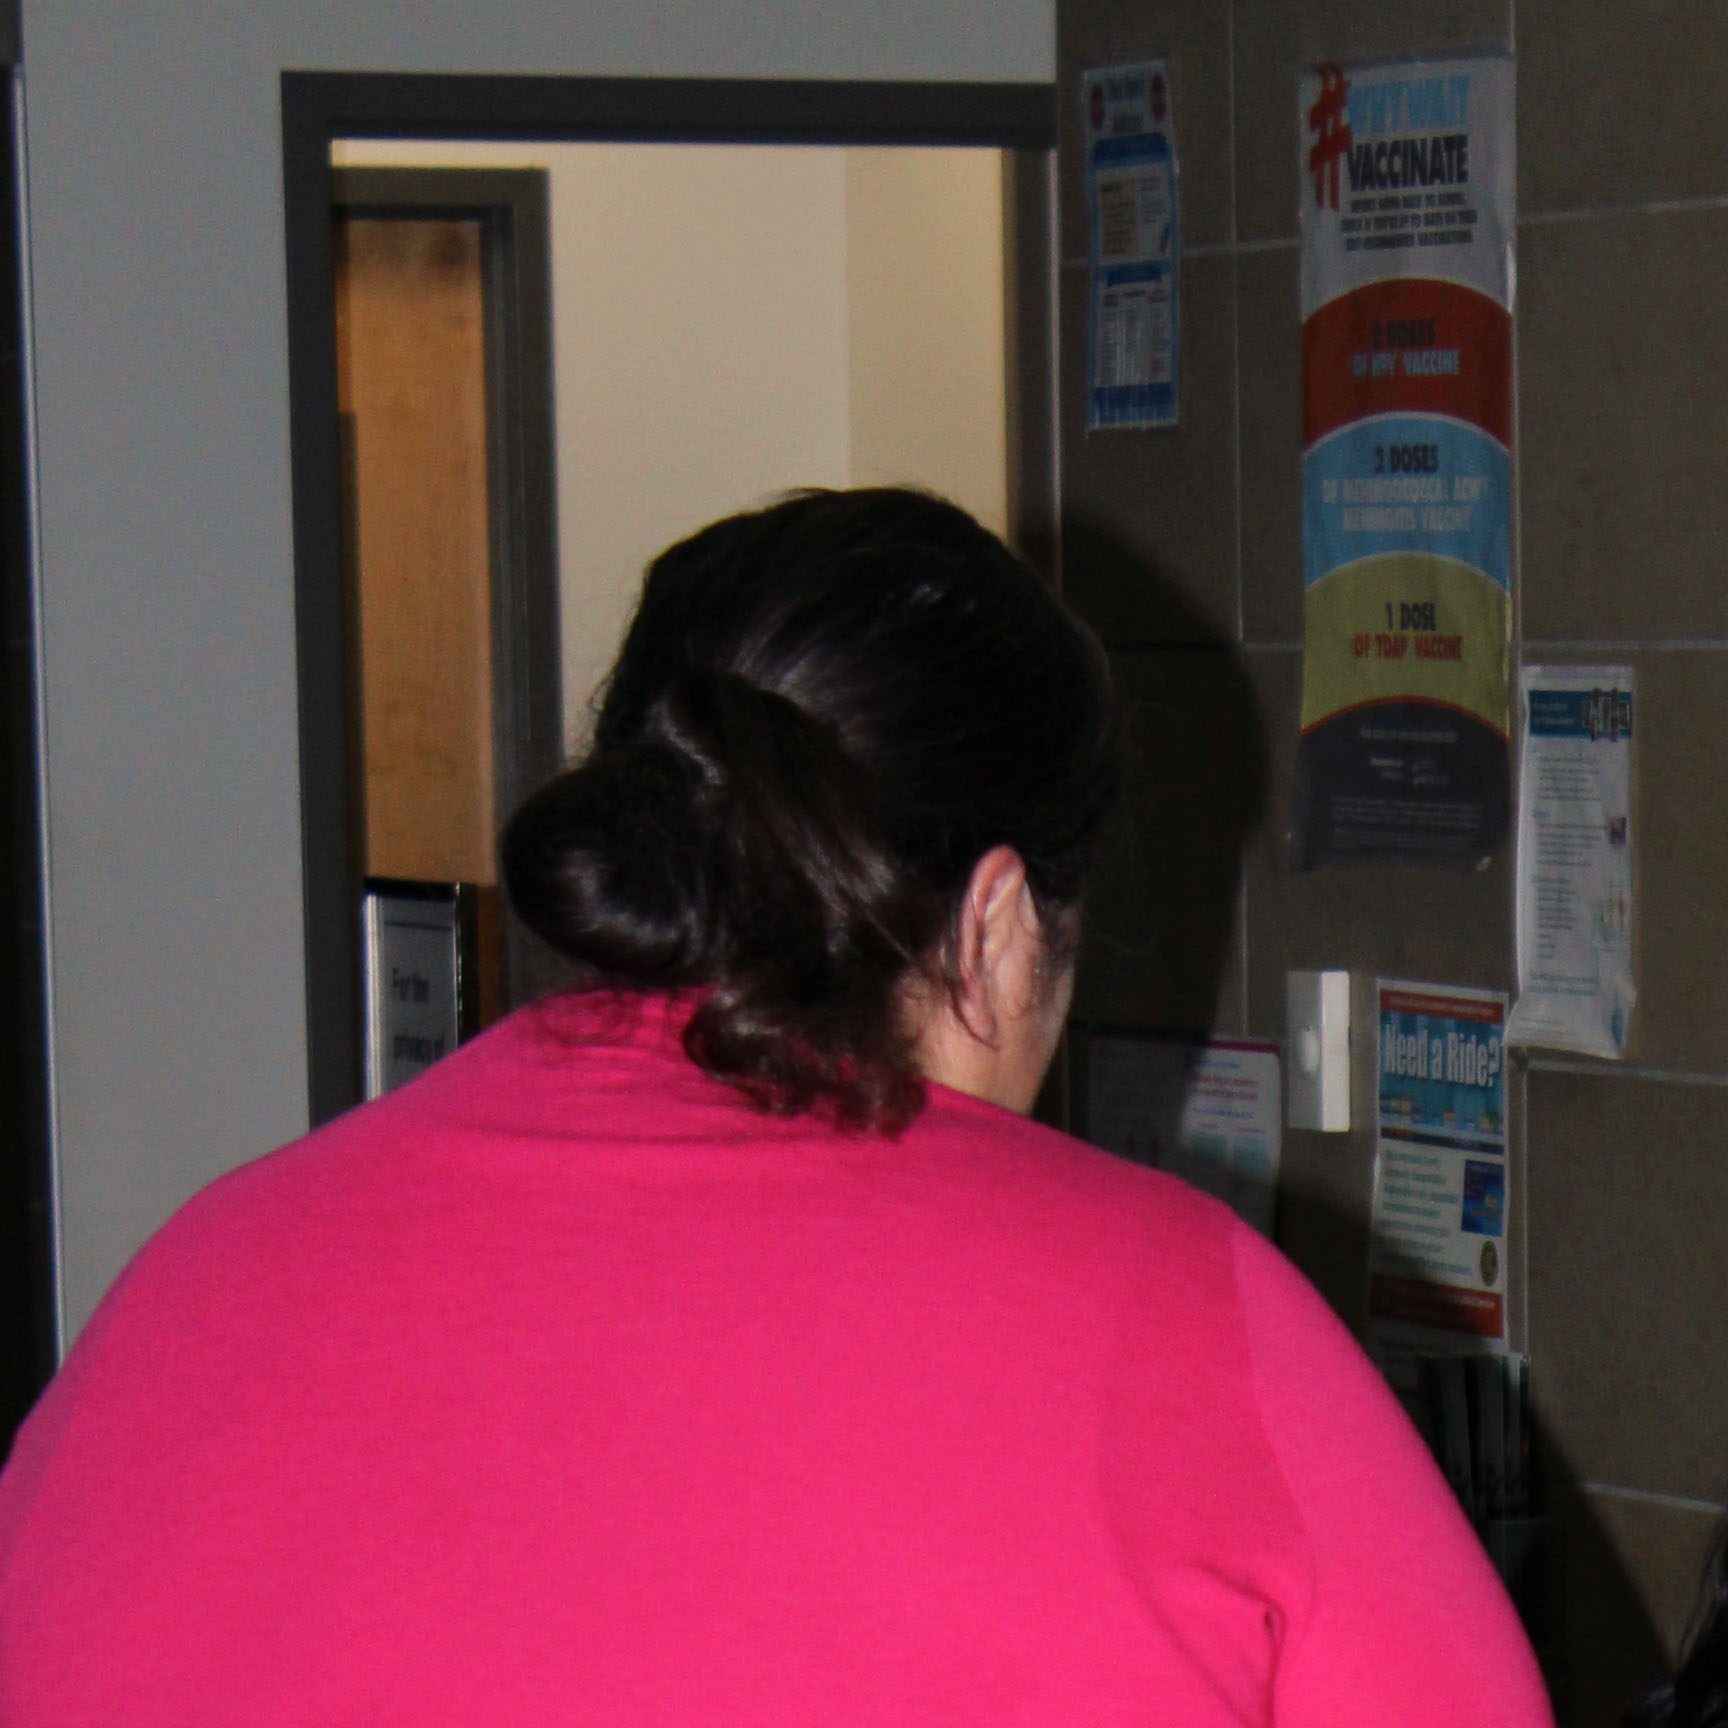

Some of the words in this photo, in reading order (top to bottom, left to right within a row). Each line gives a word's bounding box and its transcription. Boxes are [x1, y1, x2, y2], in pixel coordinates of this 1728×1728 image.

[1347, 135, 1469, 191] VACCINATE
[1403, 350, 1460, 375] VACCINE
[1389, 444, 1440, 472] DOSES
[1401, 602, 1437, 630] DOSE
[1385, 1023, 1428, 1079] Need
[1431, 1038, 1443, 1080] a
[1447, 1031, 1500, 1087] Ride?
